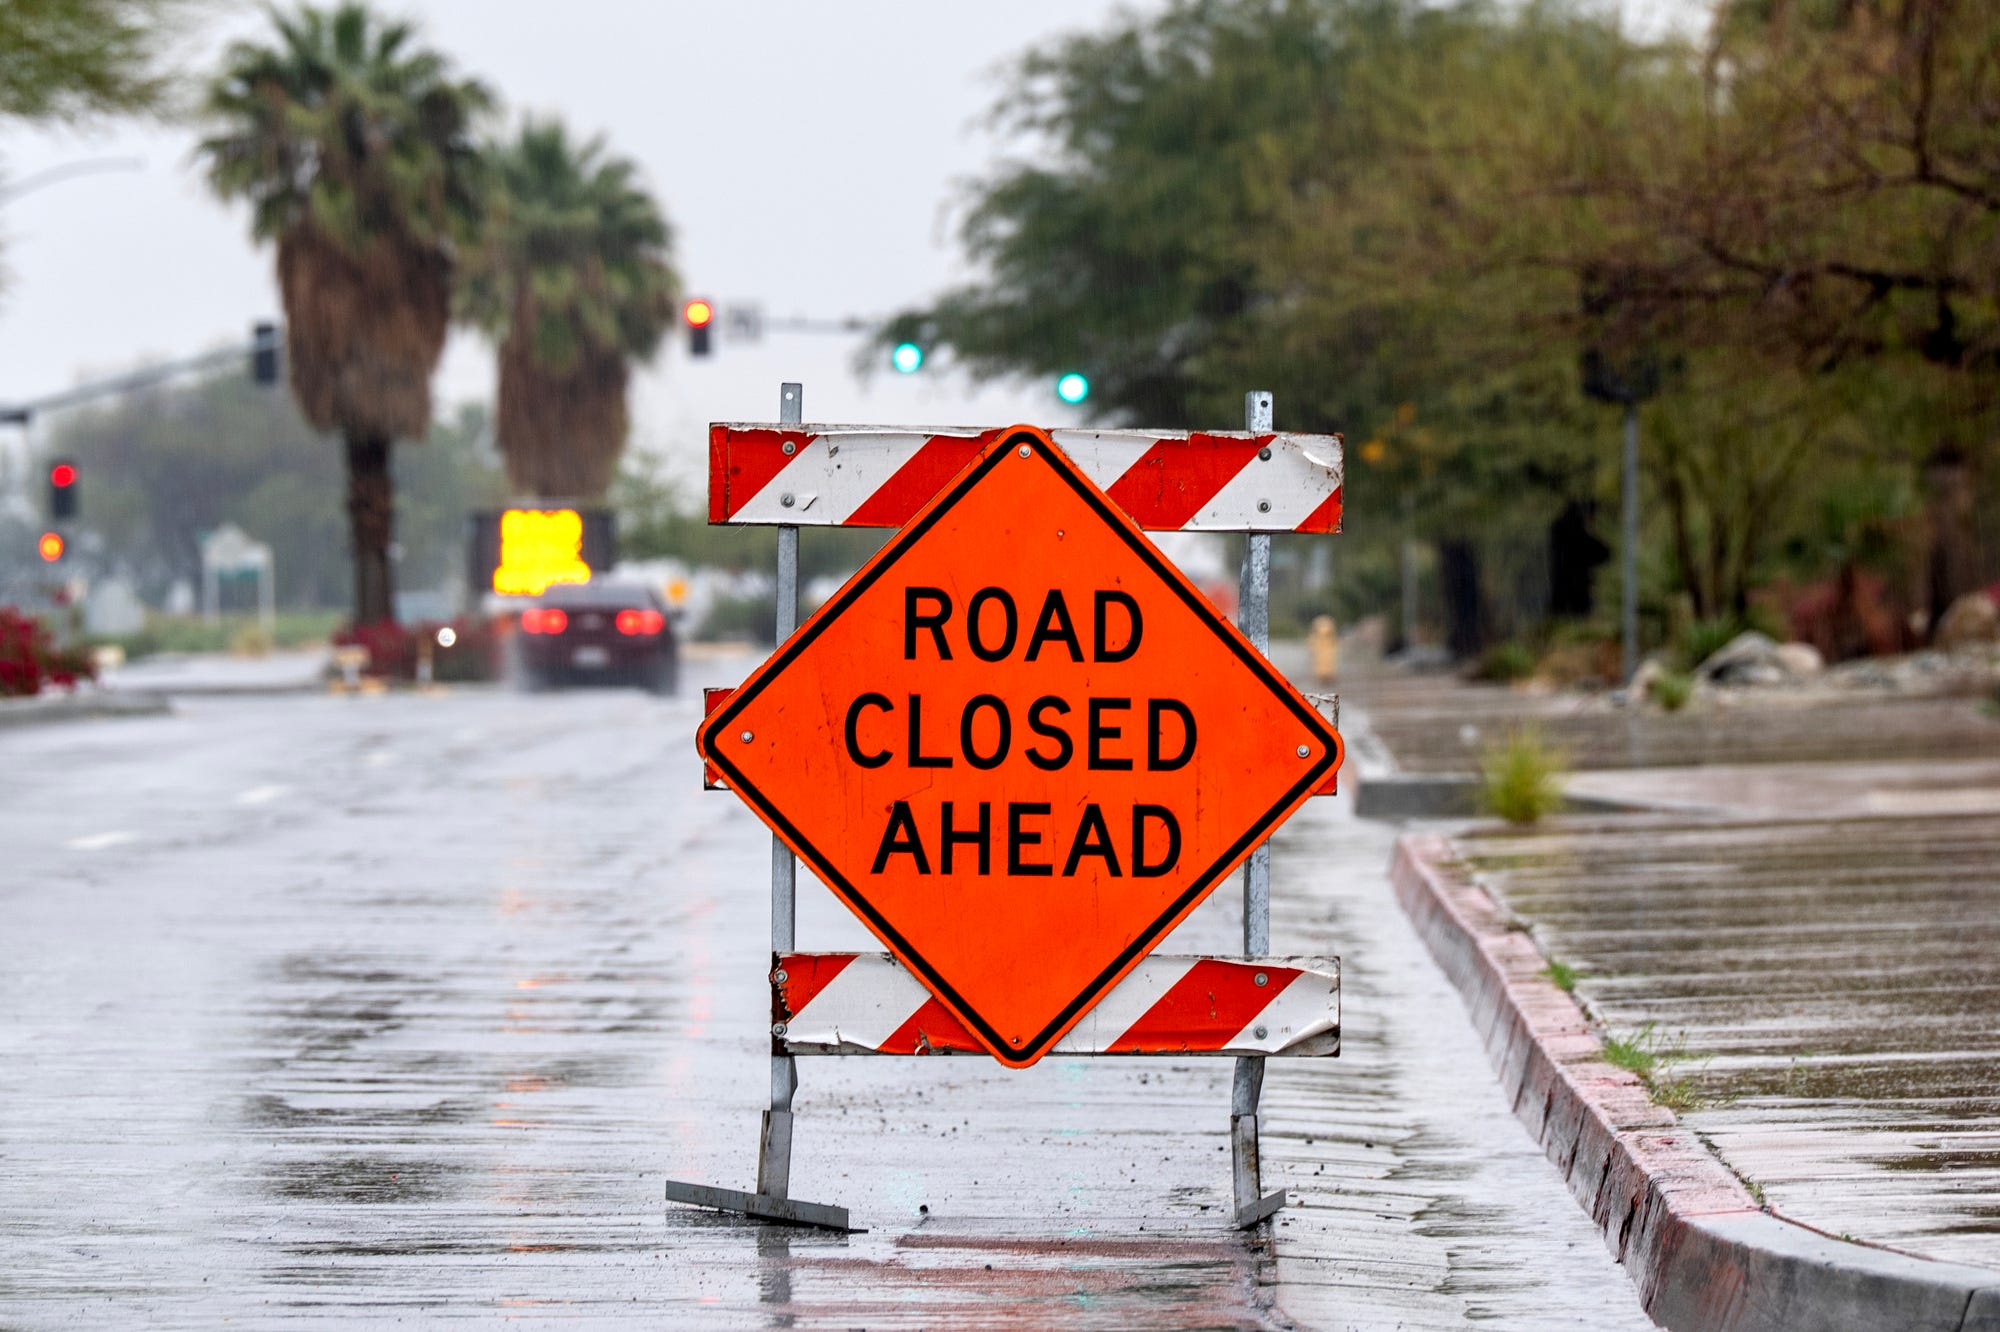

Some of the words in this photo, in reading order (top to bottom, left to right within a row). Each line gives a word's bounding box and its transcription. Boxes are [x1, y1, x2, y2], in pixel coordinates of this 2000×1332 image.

[904, 586, 1143, 663] ROAD
[844, 692, 1197, 772] CLOSED
[870, 800, 1182, 878] AHEAD
